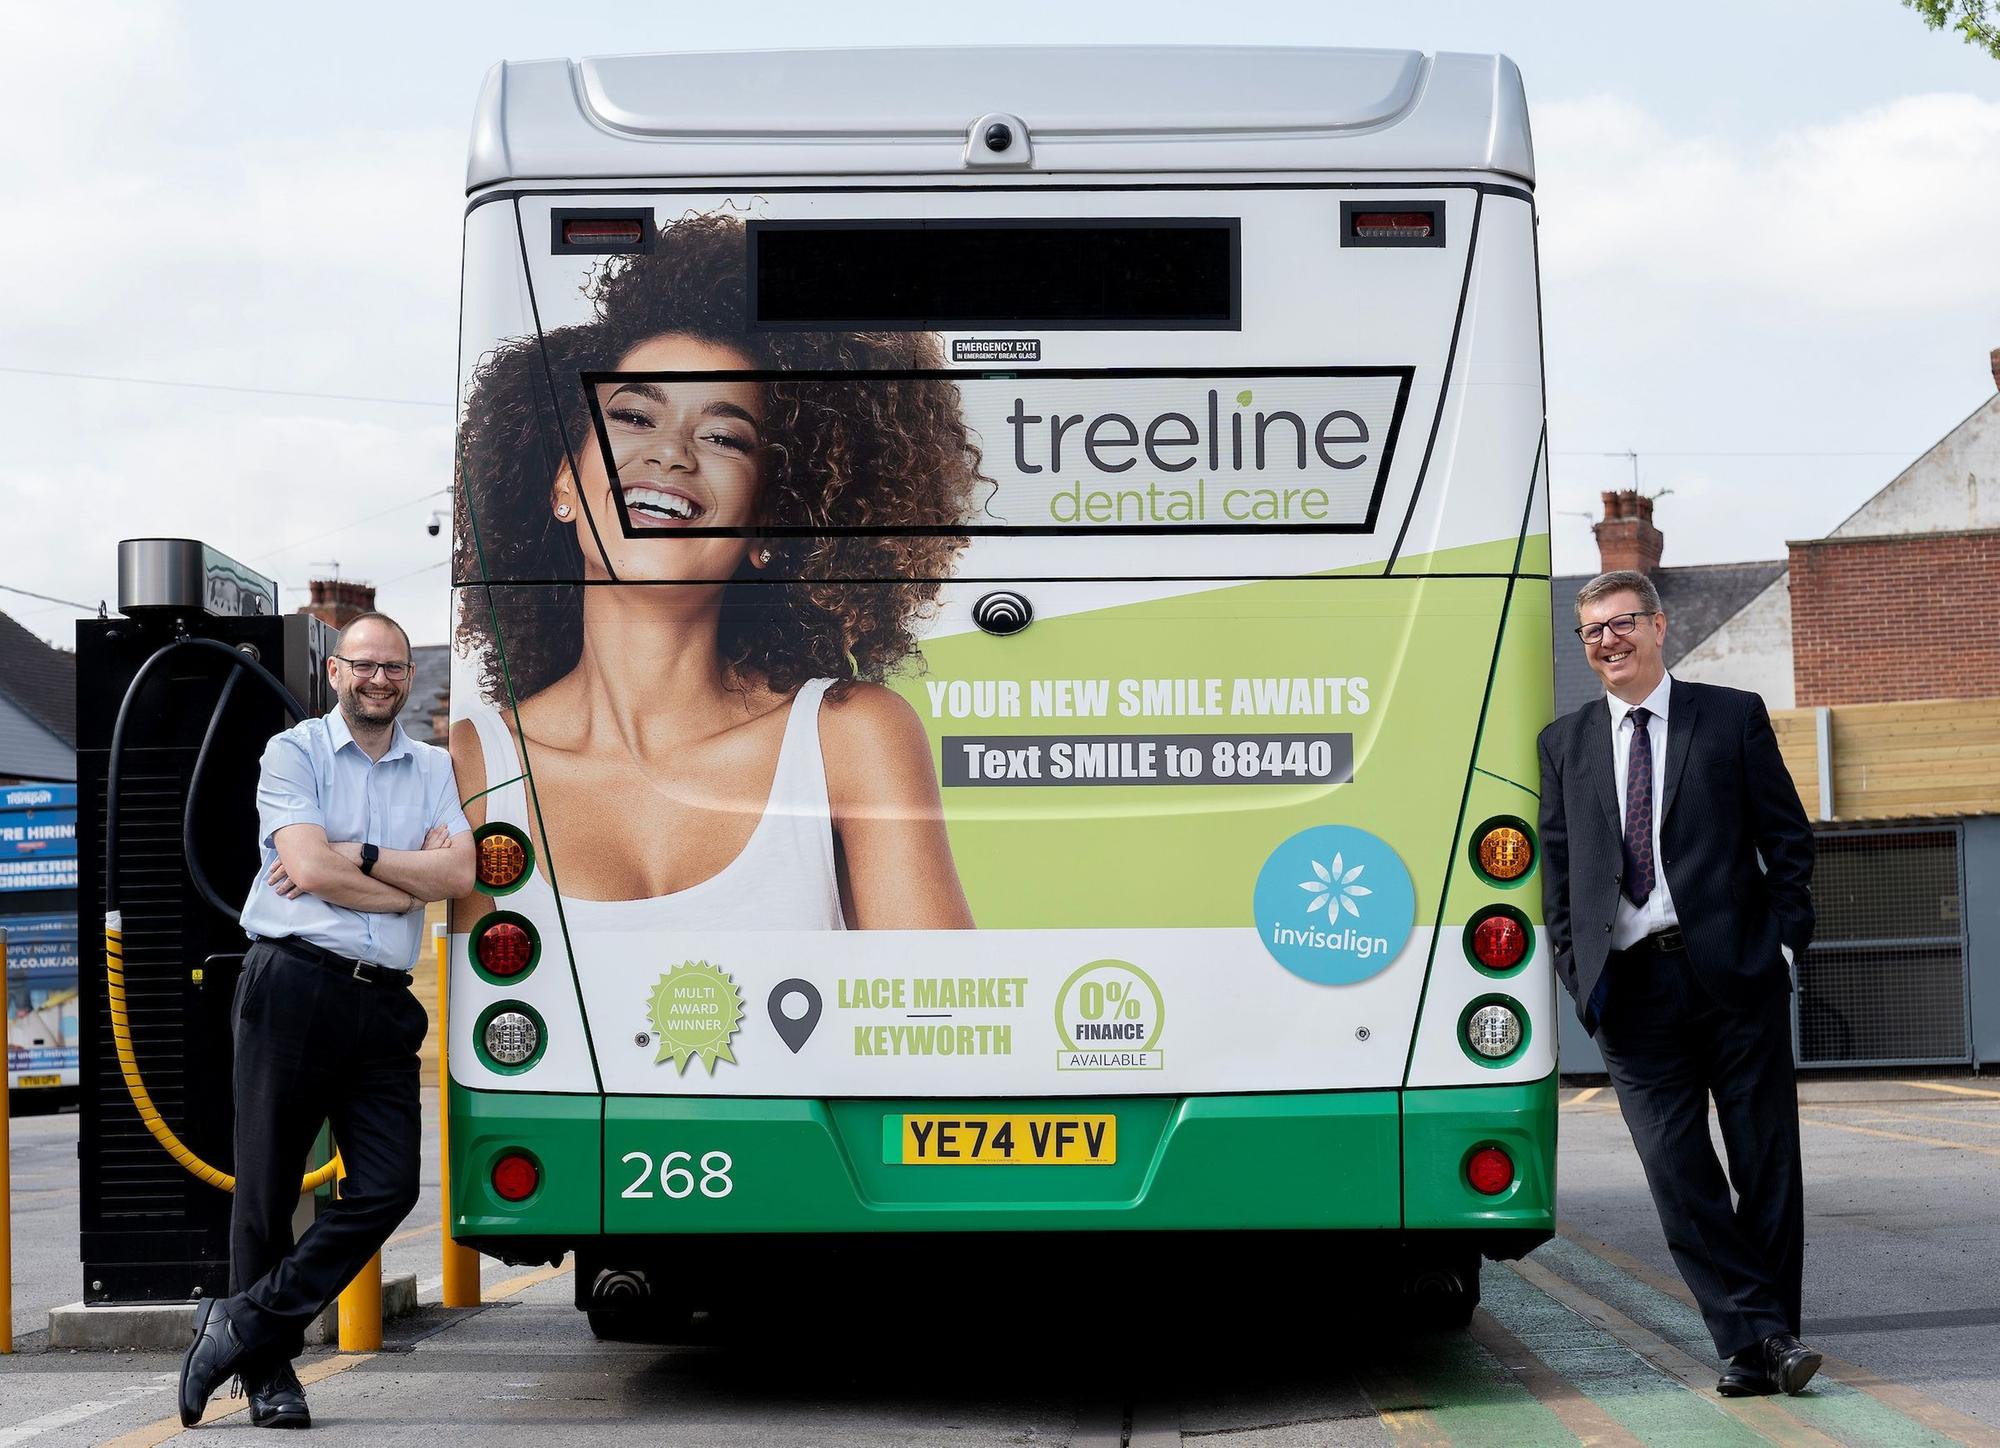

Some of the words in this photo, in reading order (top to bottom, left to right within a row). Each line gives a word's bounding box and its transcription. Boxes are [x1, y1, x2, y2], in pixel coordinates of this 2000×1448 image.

[956, 342, 1013, 351] EMERGENCY
[1016, 342, 1037, 351] EXIT
[1006, 389, 1370, 474] treeline
[1050, 478, 1205, 523] dental
[1222, 487, 1330, 520] care
[926, 680, 1021, 718] YOUR
[1030, 680, 1109, 717] NEW
[1118, 678, 1222, 717] SMILE
[1230, 676, 1371, 716] AWAITS
[963, 744, 1042, 779] Text
[1049, 743, 1157, 778] SMILE
[1164, 744, 1204, 777] to
[1212, 740, 1332, 777] 88440
[27, 825, 76, 839] HIRIN
[1273, 922, 1388, 959] invisalign
[670, 1003, 719, 1014] AWARD
[674, 987, 715, 999] MULTI
[838, 978, 906, 1009] LACE
[913, 978, 1028, 1009] MARKET
[1079, 981, 1141, 1020] 0%
[667, 1019, 722, 1031] WINNER
[854, 1025, 1012, 1055] KEYWORTH
[1076, 1023, 1145, 1040] FINANCE
[1070, 1053, 1147, 1066] AVAILABLE
[911, 1121, 1015, 1158] YE74
[1029, 1121, 1106, 1158] VFV
[620, 1150, 734, 1199] 268
